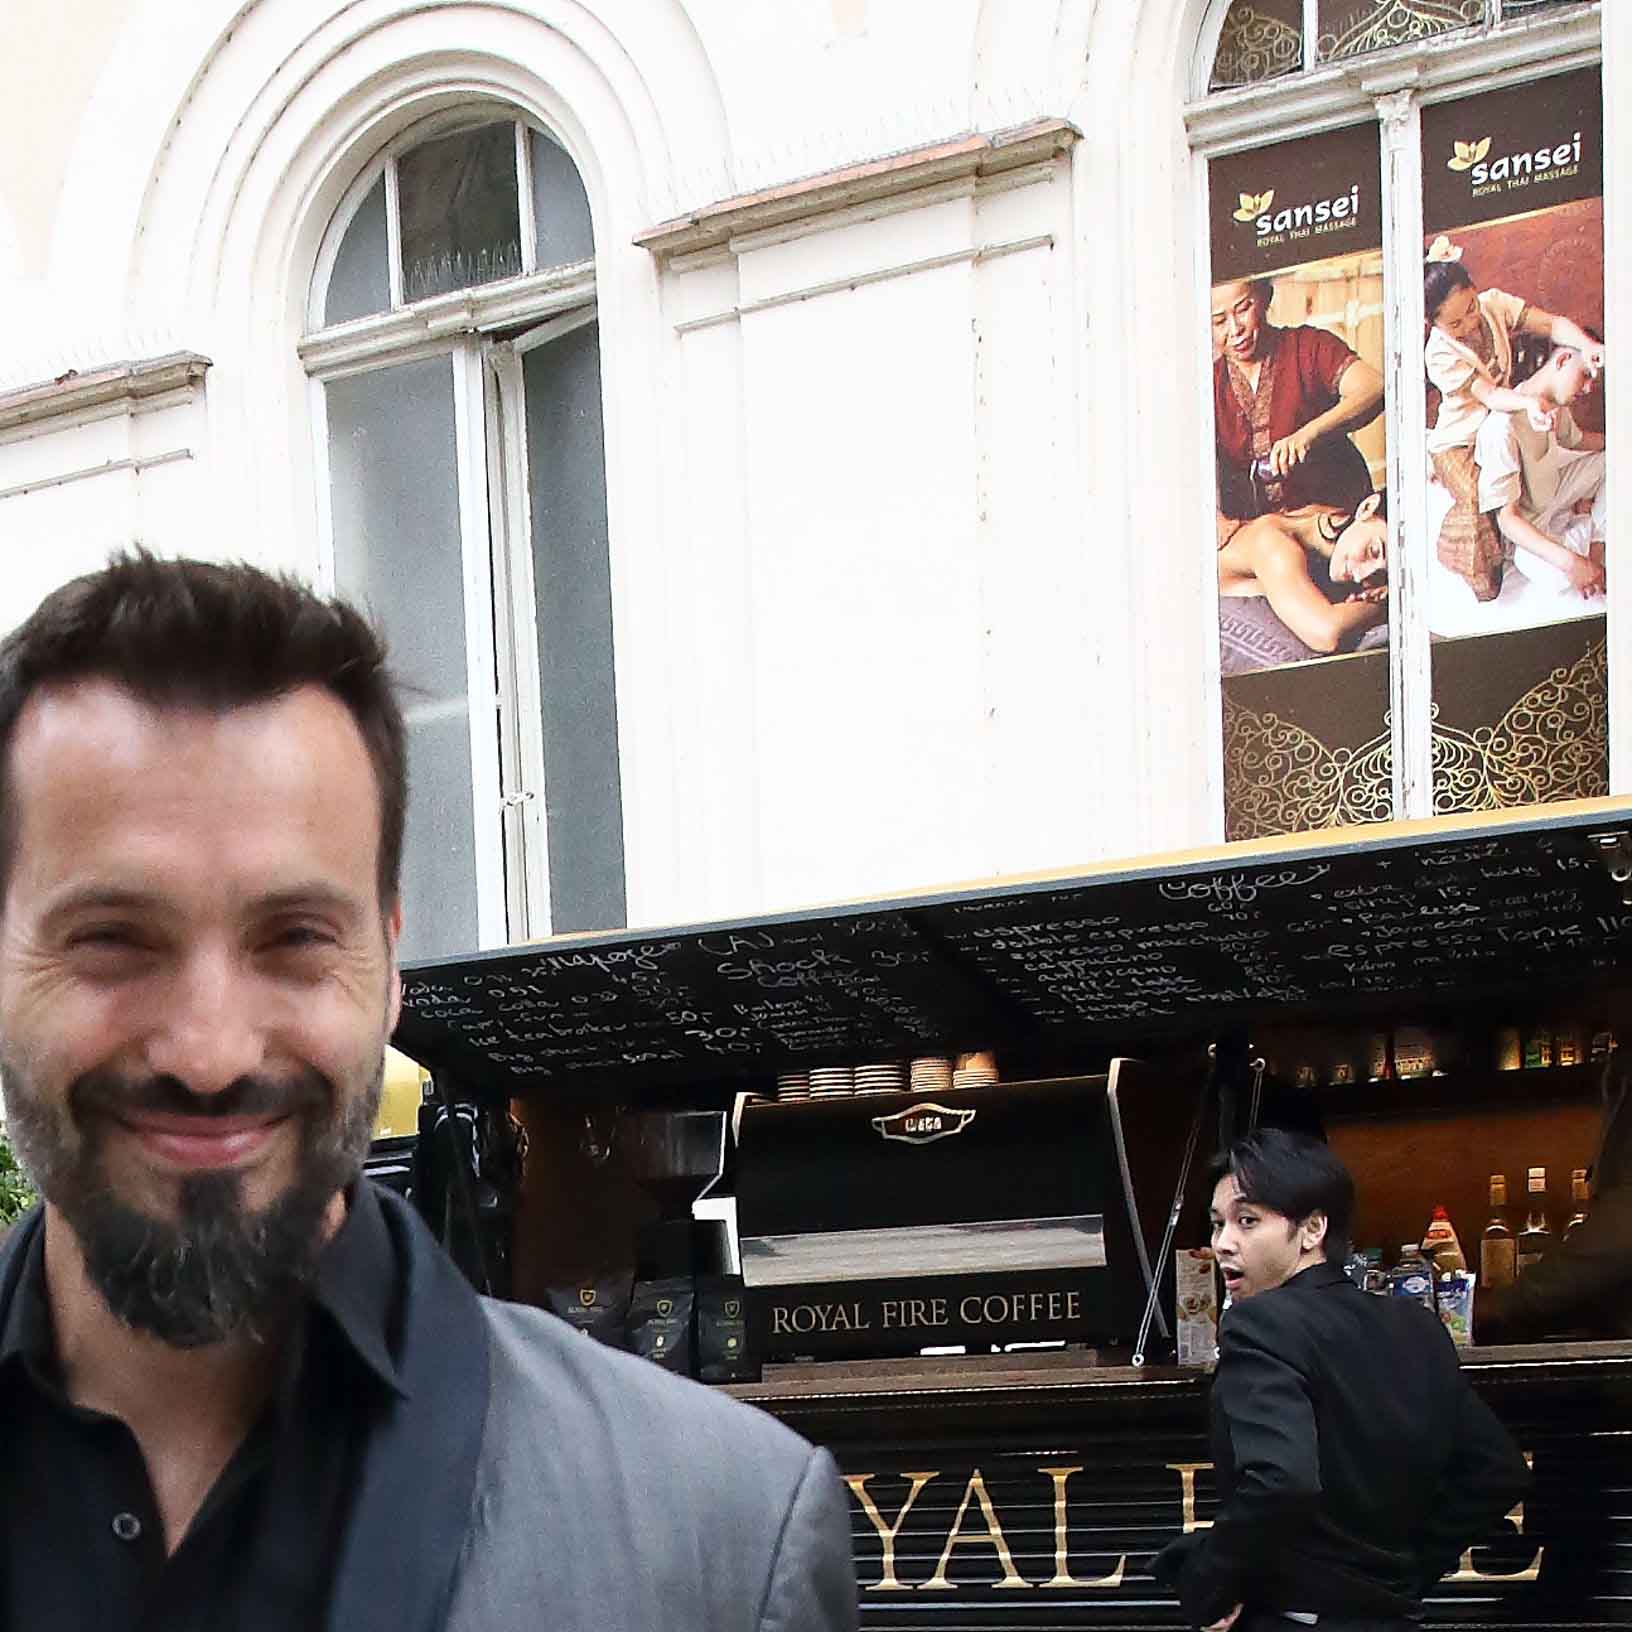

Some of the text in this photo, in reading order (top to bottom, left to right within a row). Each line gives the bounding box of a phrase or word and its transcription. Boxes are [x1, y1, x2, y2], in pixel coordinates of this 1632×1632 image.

[1472, 131, 1582, 185] sansei
[1256, 184, 1359, 236] sansei
[771, 1291, 1082, 1335] ROYAL FIRE COFFEE
[839, 1468, 1126, 1592] YAL
